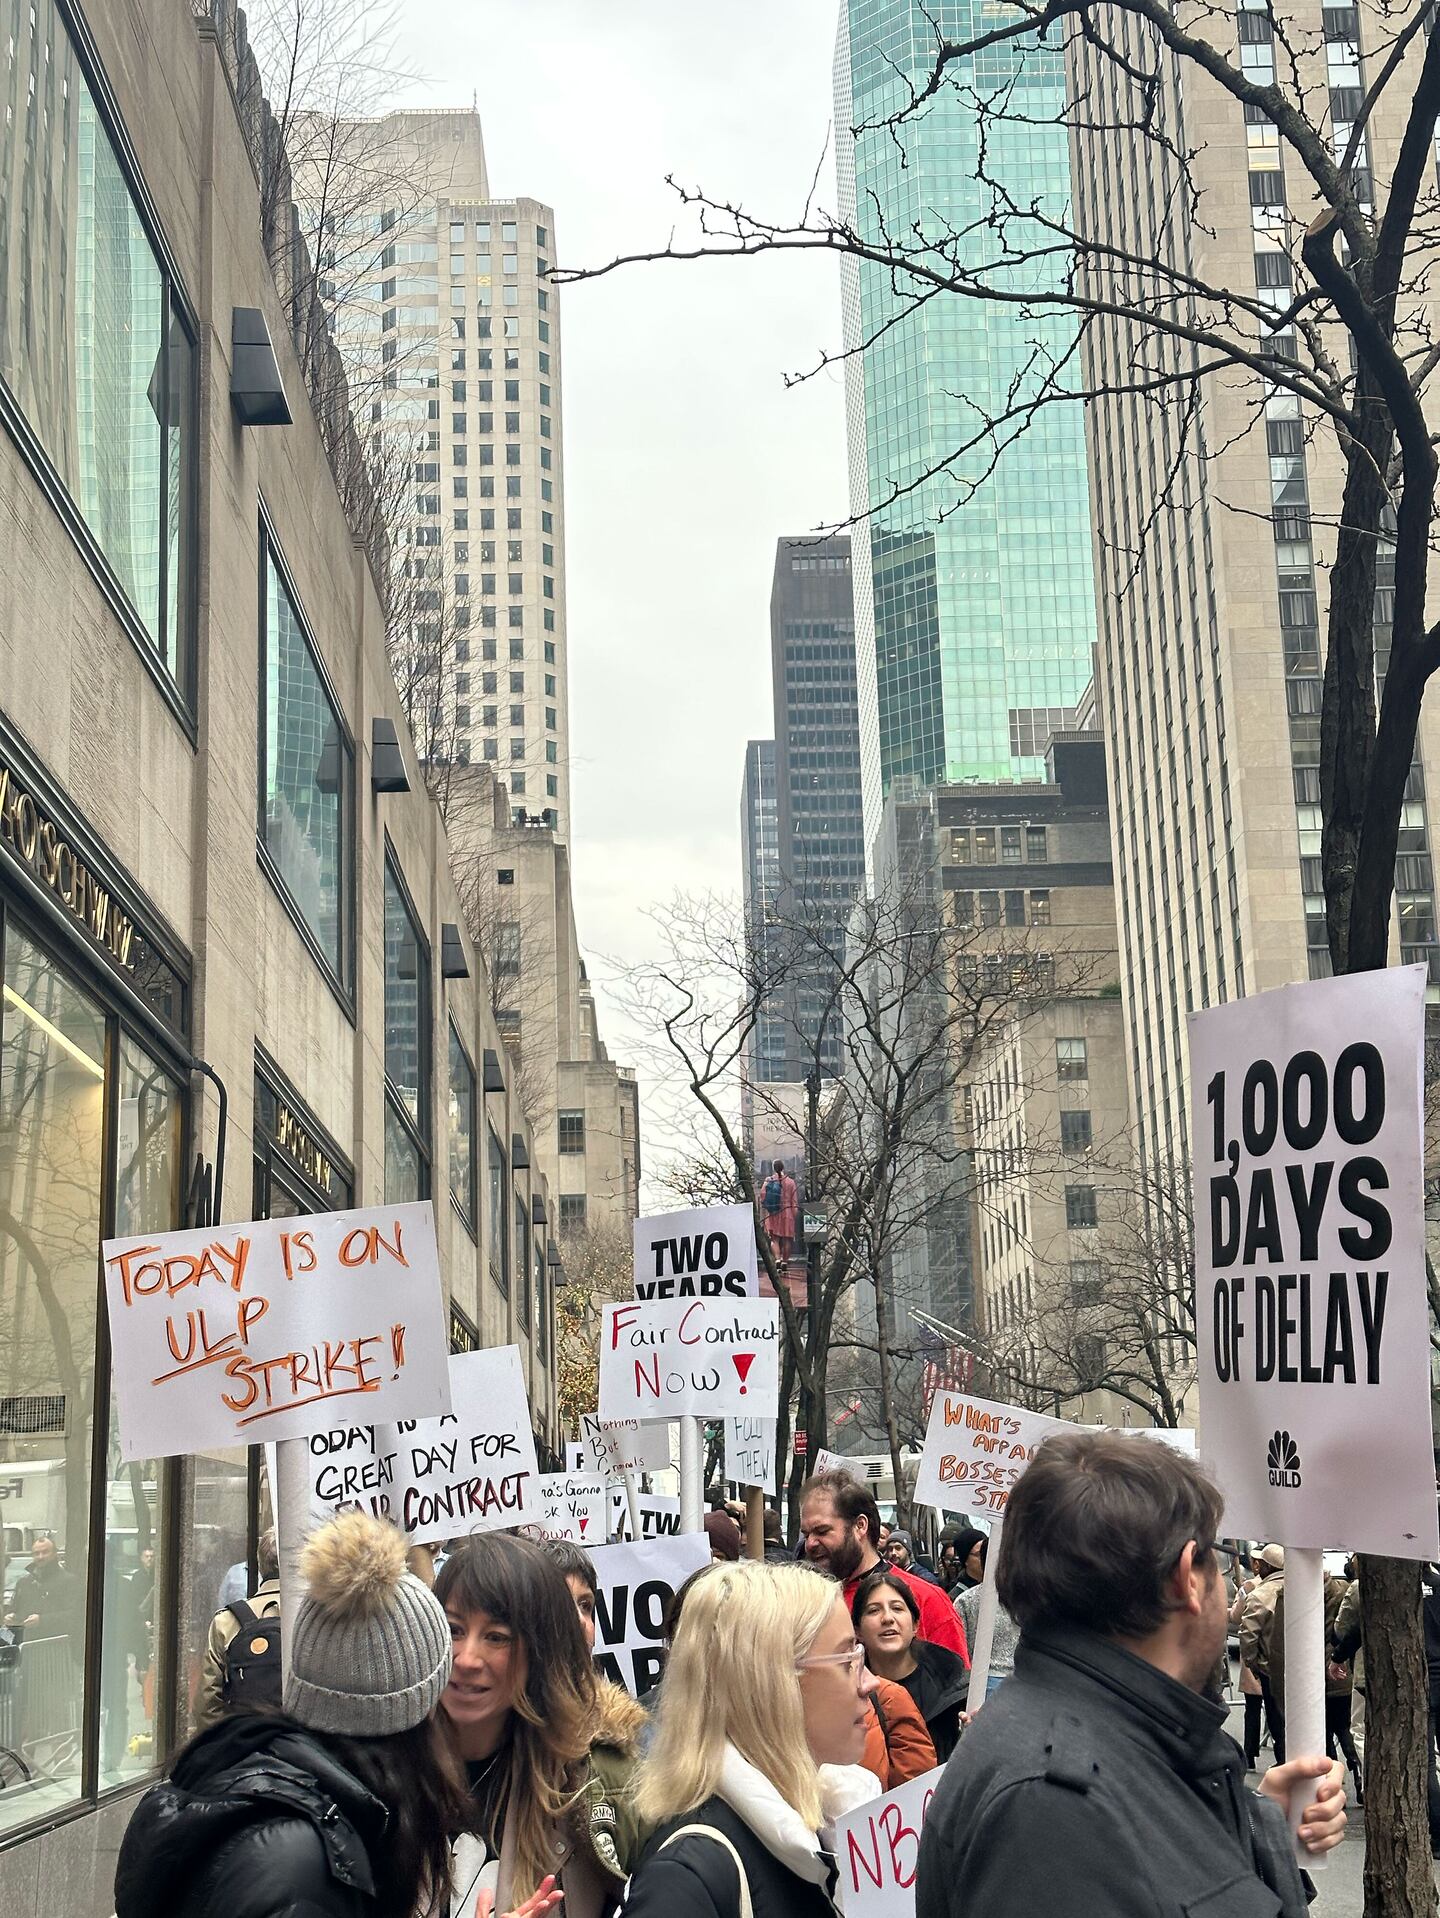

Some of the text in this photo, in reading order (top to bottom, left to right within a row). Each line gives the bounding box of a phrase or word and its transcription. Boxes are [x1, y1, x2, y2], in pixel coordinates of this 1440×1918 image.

[1207, 1042, 1386, 1177] 1,000
[1210, 1156, 1393, 1268] DAYS
[107, 1221, 410, 1306] TODAY IS ON
[651, 1231, 729, 1277] TWO
[165, 1296, 269, 1364] ULP
[611, 1301, 779, 1351] Fair Contract
[1213, 1271, 1390, 1385] OF DELAY
[222, 1323, 406, 1412] STRIKE!
[583, 1415, 638, 1436] Nothing
[944, 1397, 1022, 1435] WHAT'S
[310, 1424, 376, 1456] ODAY
[589, 1437, 618, 1457] But
[315, 1434, 521, 1502] GREAT DAY FOR
[939, 1454, 1020, 1486] BOSSES
[1268, 1469, 1302, 1488] GUILD
[403, 1471, 530, 1532] CONTRACT
[567, 1500, 588, 1518] You
[971, 1485, 1010, 1511] STA
[640, 1509, 681, 1537] TW
